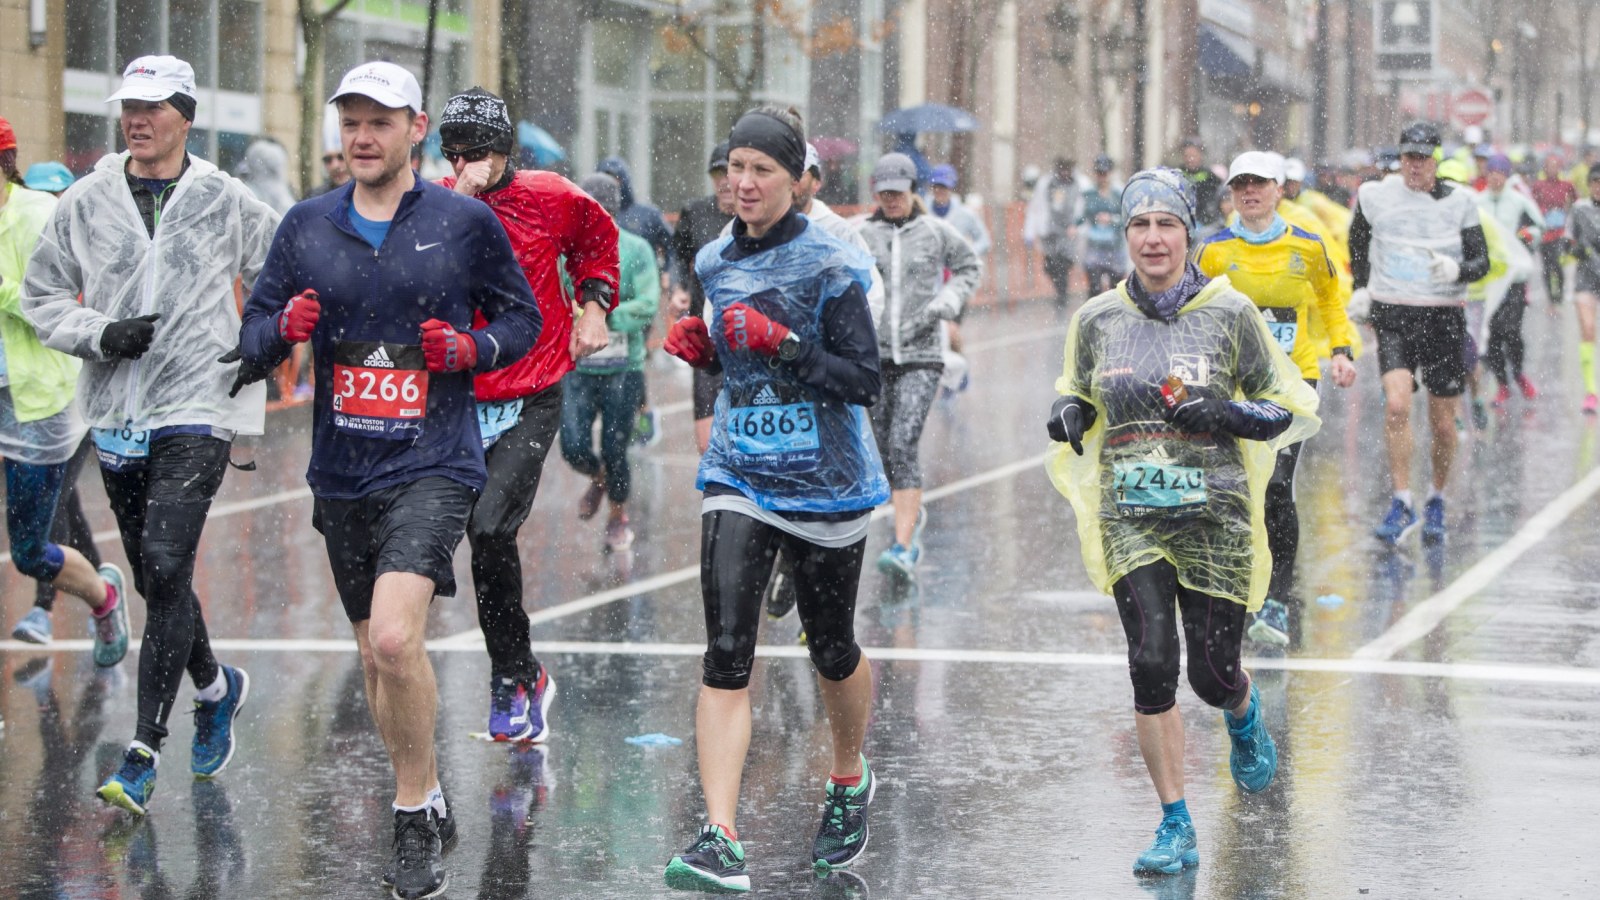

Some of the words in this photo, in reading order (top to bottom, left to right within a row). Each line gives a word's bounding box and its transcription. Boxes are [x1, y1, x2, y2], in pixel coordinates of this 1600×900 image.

[364, 359, 394, 368] adidas
[341, 369, 419, 402] 3266
[335, 397, 341, 409] 4
[362, 418, 385, 426] BOSTON
[732, 407, 813, 437] 16865
[348, 423, 385, 432] MARATHON
